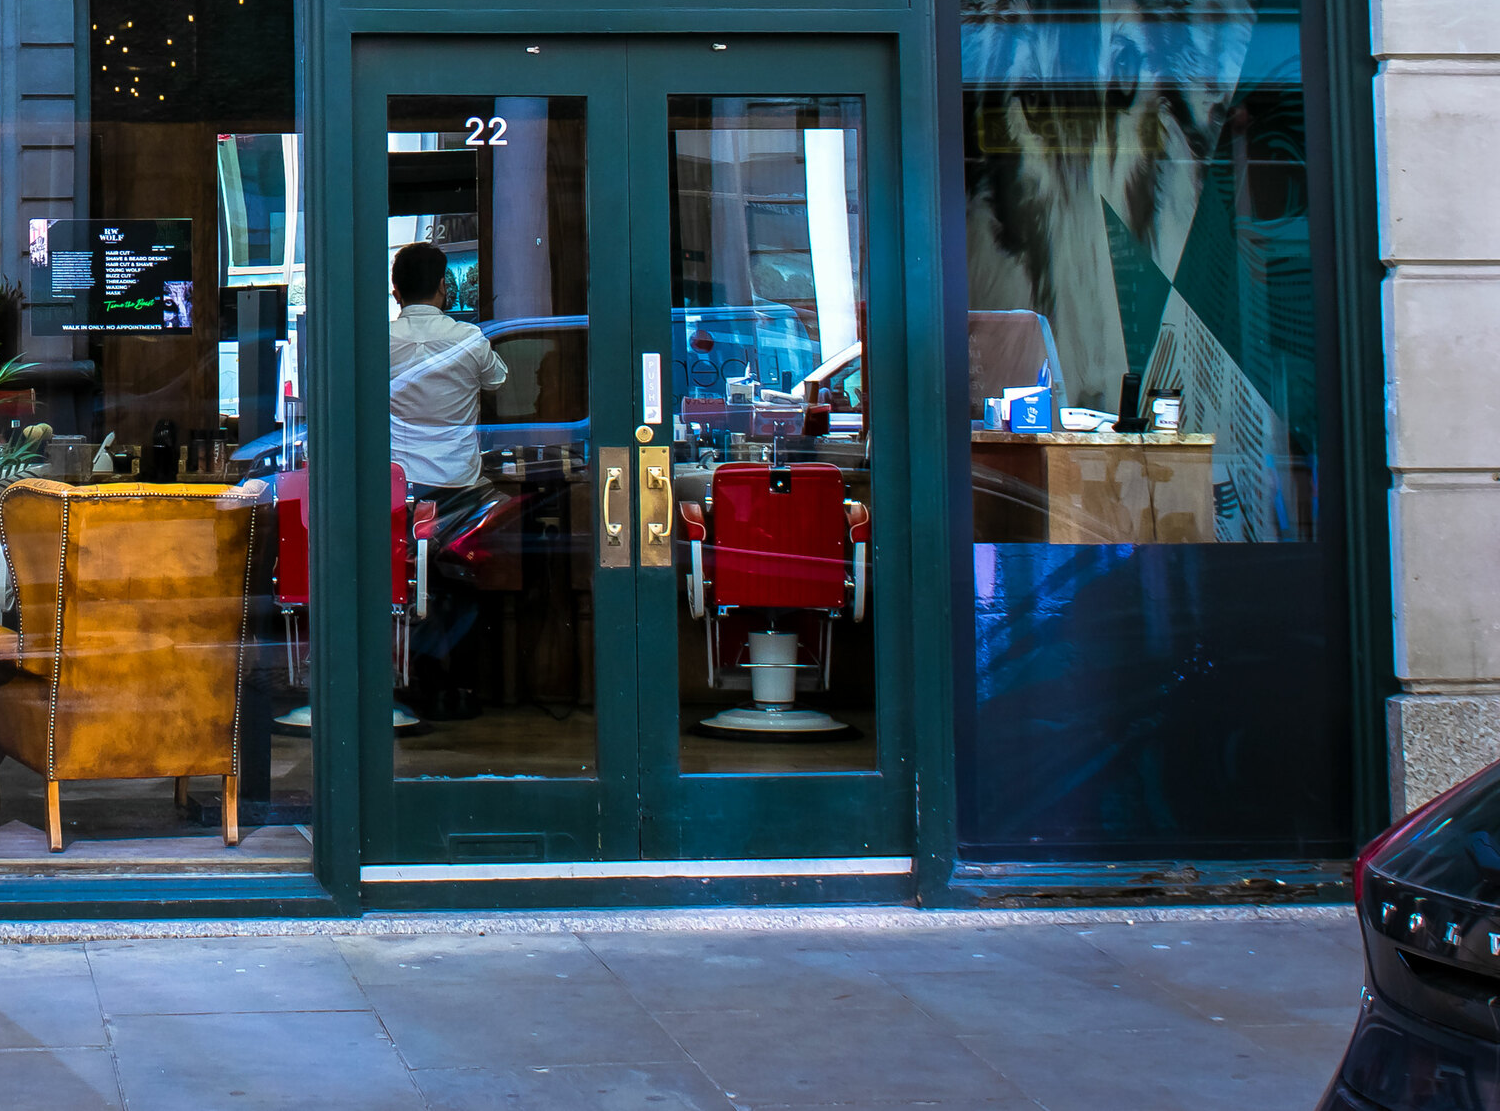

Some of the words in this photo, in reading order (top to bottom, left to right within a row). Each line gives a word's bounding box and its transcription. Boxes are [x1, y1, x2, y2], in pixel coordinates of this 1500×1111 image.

[465, 116, 509, 146] 22
[99, 234, 125, 242] WOLF
[425, 224, 446, 240] 22
[648, 360, 656, 402] PUSH
